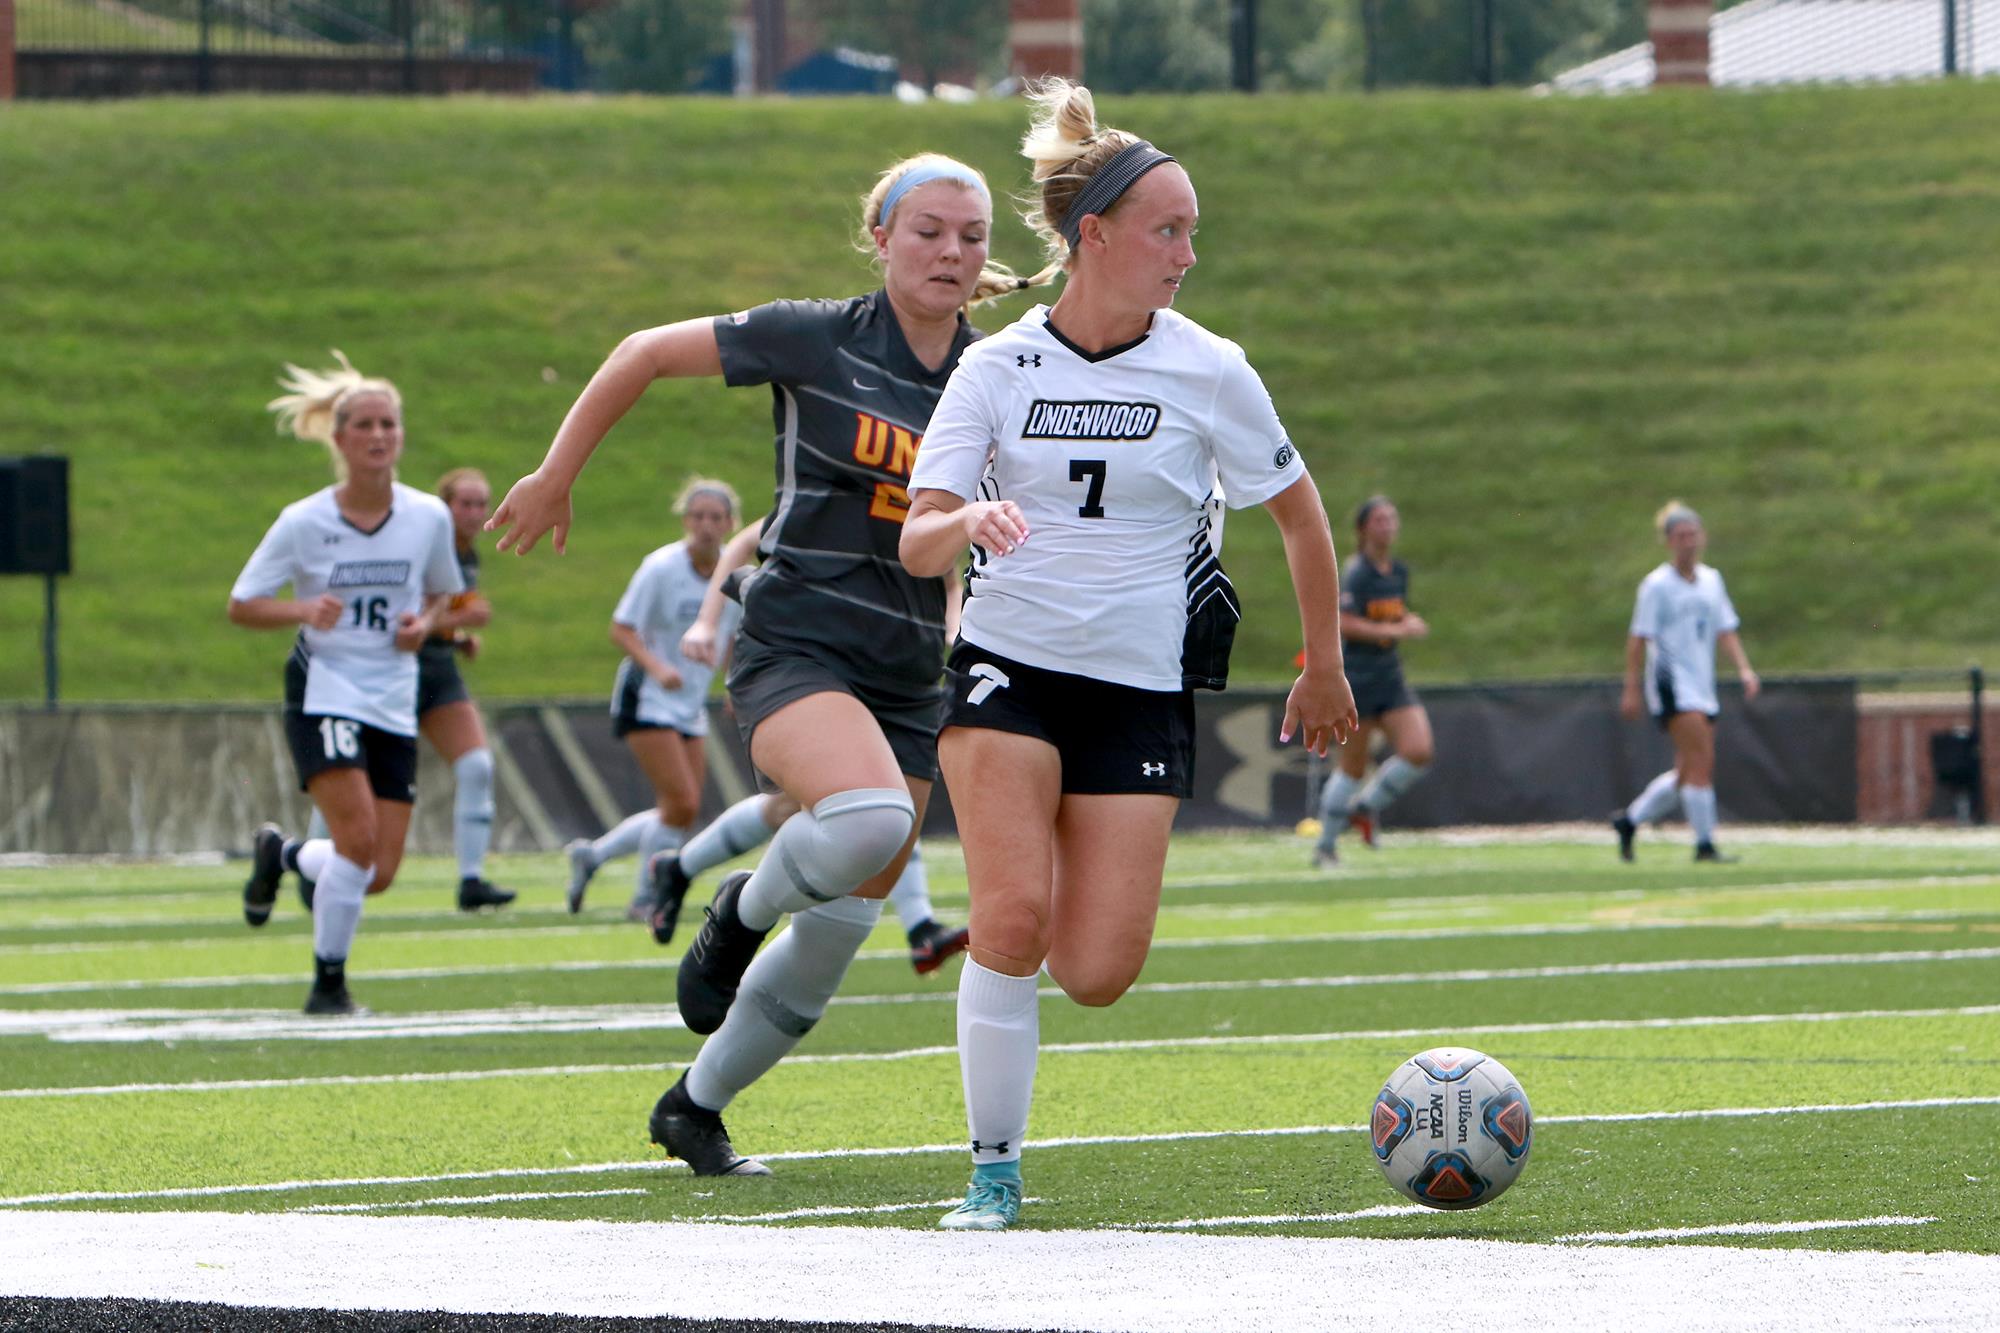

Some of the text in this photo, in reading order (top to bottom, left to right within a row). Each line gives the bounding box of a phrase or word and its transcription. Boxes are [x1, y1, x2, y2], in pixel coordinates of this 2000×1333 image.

[1025, 402, 1158, 437] LINDENWOOD
[1069, 460, 1106, 517] 7
[351, 596, 388, 632] 16
[967, 663, 1009, 705] 7
[319, 717, 360, 759] 16
[1430, 1093, 1444, 1139] NCAA
[1457, 1089, 1472, 1144] Wilson
